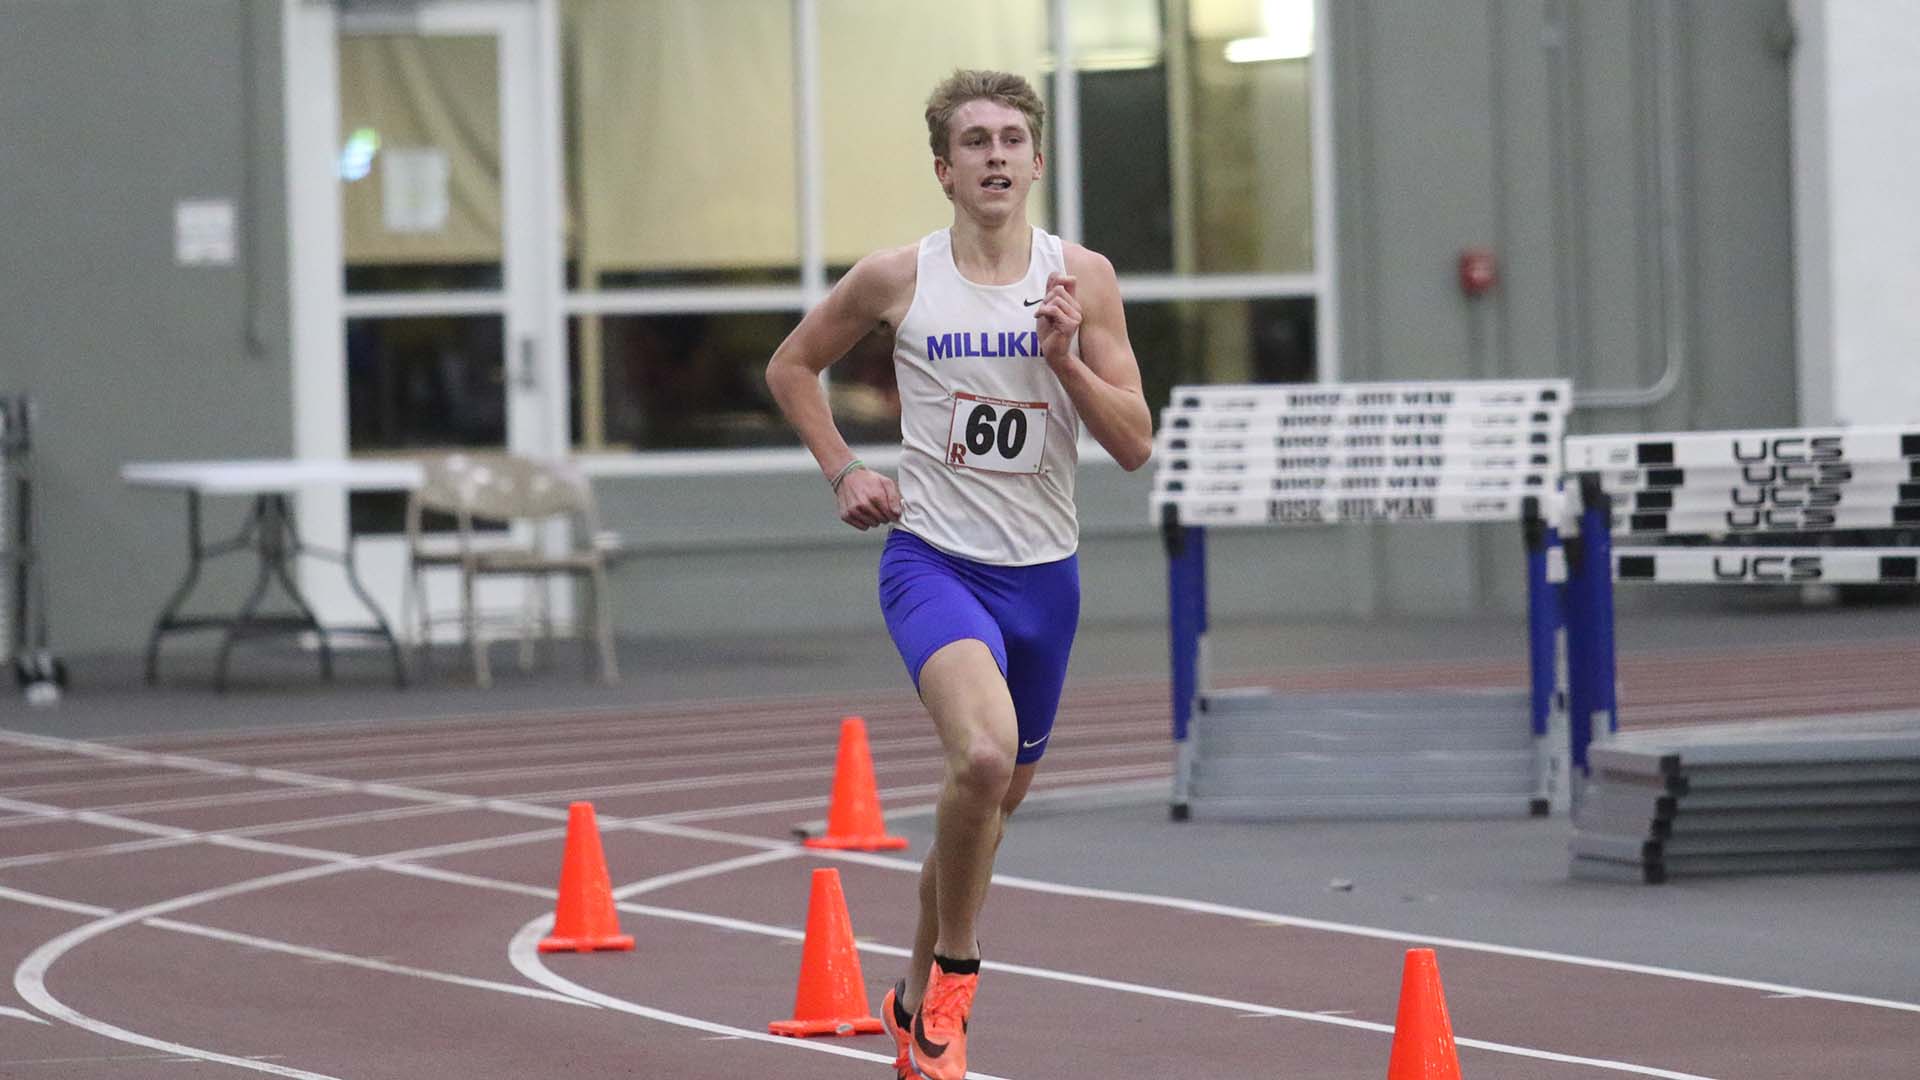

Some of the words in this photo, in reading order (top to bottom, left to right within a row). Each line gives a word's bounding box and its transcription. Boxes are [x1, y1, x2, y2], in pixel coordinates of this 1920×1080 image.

[927, 331, 1044, 361] MILLIKI
[965, 404, 1027, 459] 60
[951, 443, 966, 464] R
[1734, 437, 1842, 463] UCS
[1743, 464, 1851, 484] UCS
[1732, 486, 1840, 506] UCS
[1726, 509, 1835, 528] UCS
[1714, 556, 1821, 579] UCS
